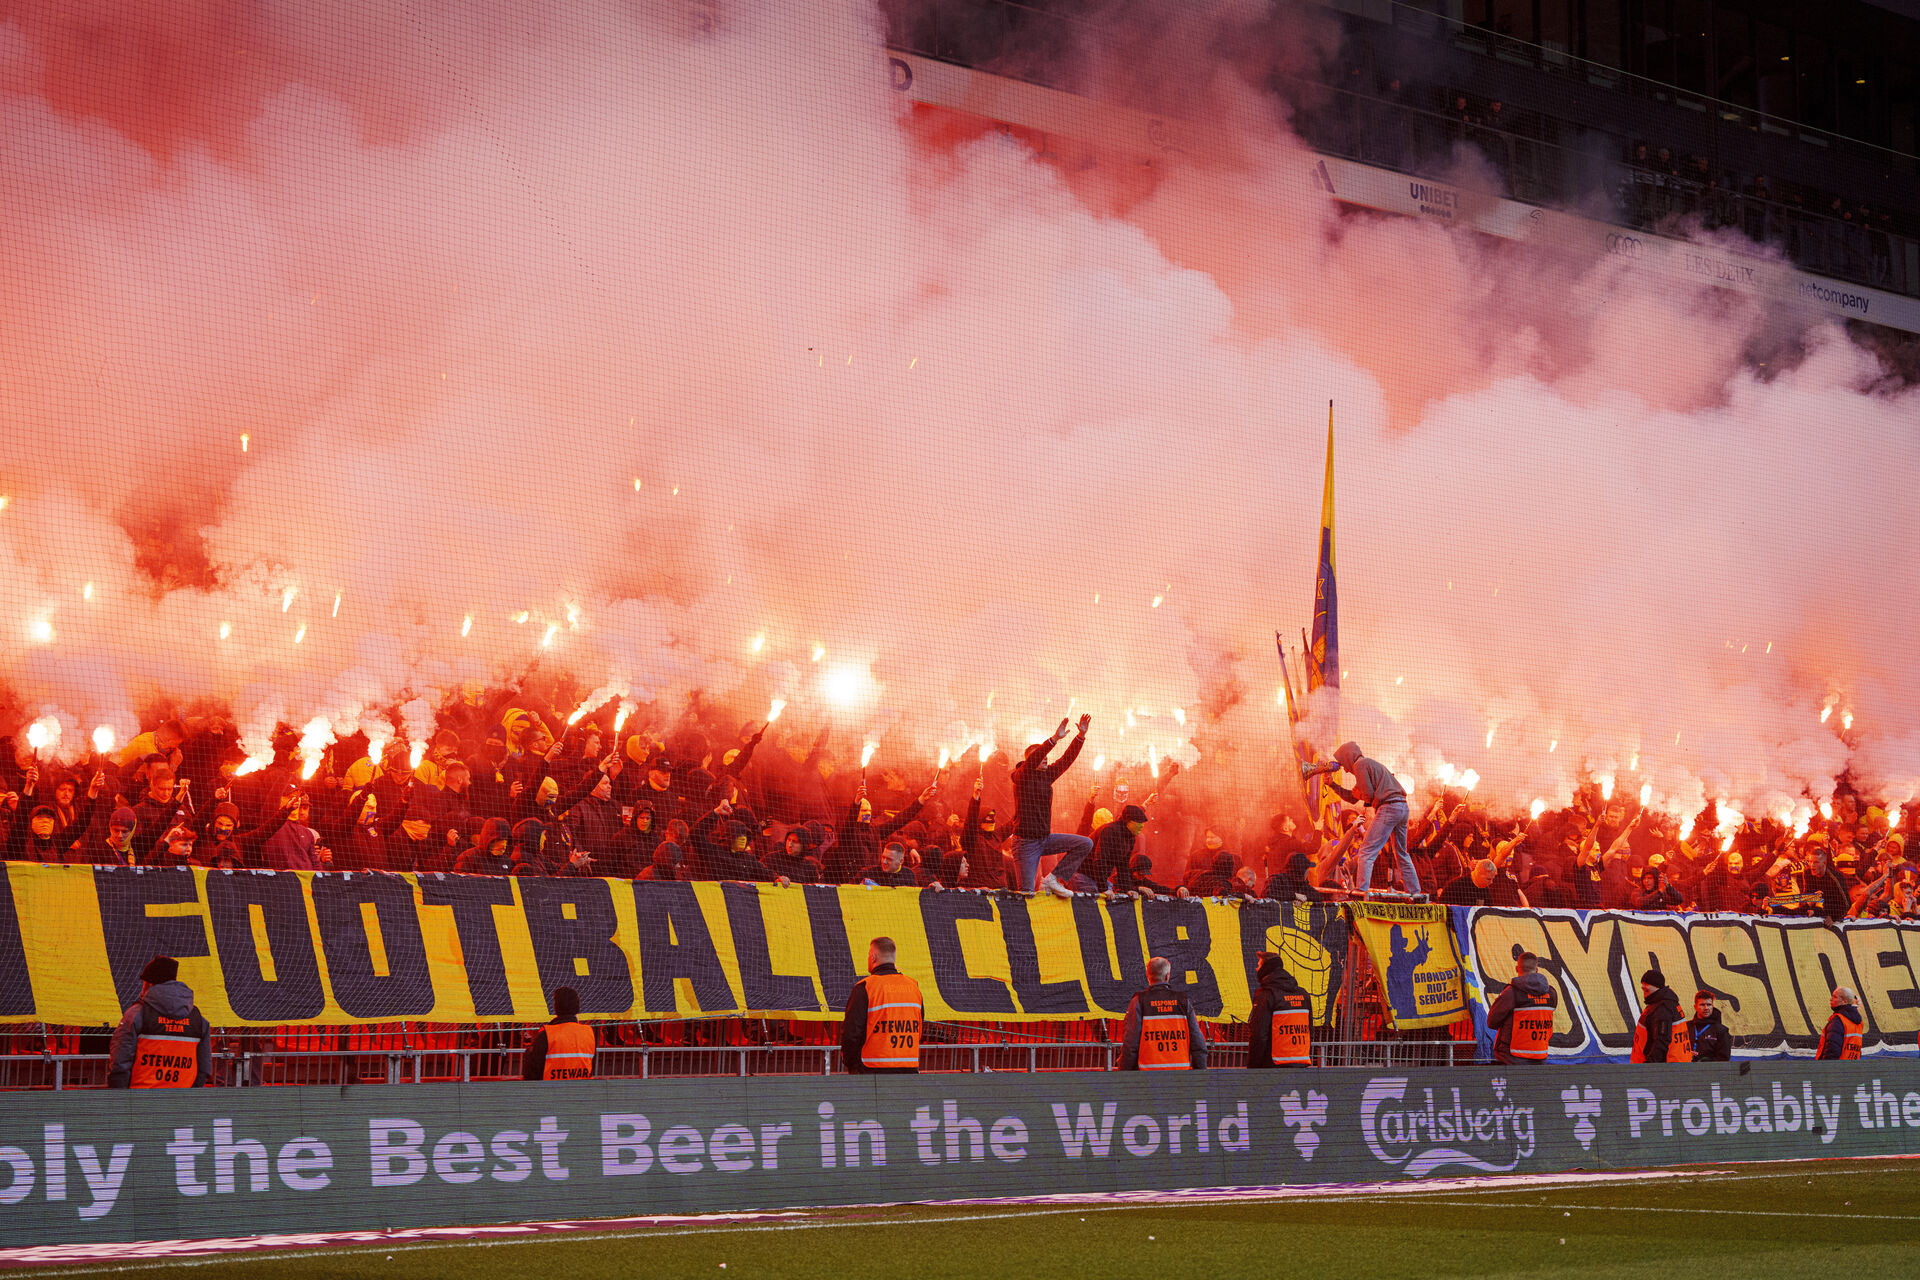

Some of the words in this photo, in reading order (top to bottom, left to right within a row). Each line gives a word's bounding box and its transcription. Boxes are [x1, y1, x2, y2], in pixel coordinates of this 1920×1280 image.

[1410, 182, 1459, 209] UNIBET
[1684, 253, 1711, 276] LES
[1716, 262, 1754, 284] DEUX
[1800, 282, 1870, 313] netcompany
[1398, 904, 1434, 919] UNITY
[919, 886, 1224, 1018] CLUB
[1474, 908, 1920, 1049] SYDSIDE
[1427, 982, 1447, 994] RIOT
[1418, 989, 1459, 1006] SERVICE
[165, 1024, 184, 1033] TEAM
[873, 1020, 919, 1034] STEWAR
[890, 1035, 914, 1049] 970
[1157, 1041, 1178, 1052] 013
[141, 1054, 193, 1069] STEWARD
[155, 1069, 180, 1082] 068
[1627, 1080, 1841, 1145] Probably
[1854, 1078, 1920, 1129] the
[1360, 1077, 1536, 1179] Carlsberg
[166, 1118, 334, 1197] the
[369, 1115, 570, 1188] Best
[600, 1111, 793, 1177] Beer
[818, 1101, 887, 1168] in
[910, 1099, 1029, 1166] the
[1051, 1100, 1251, 1159] World
